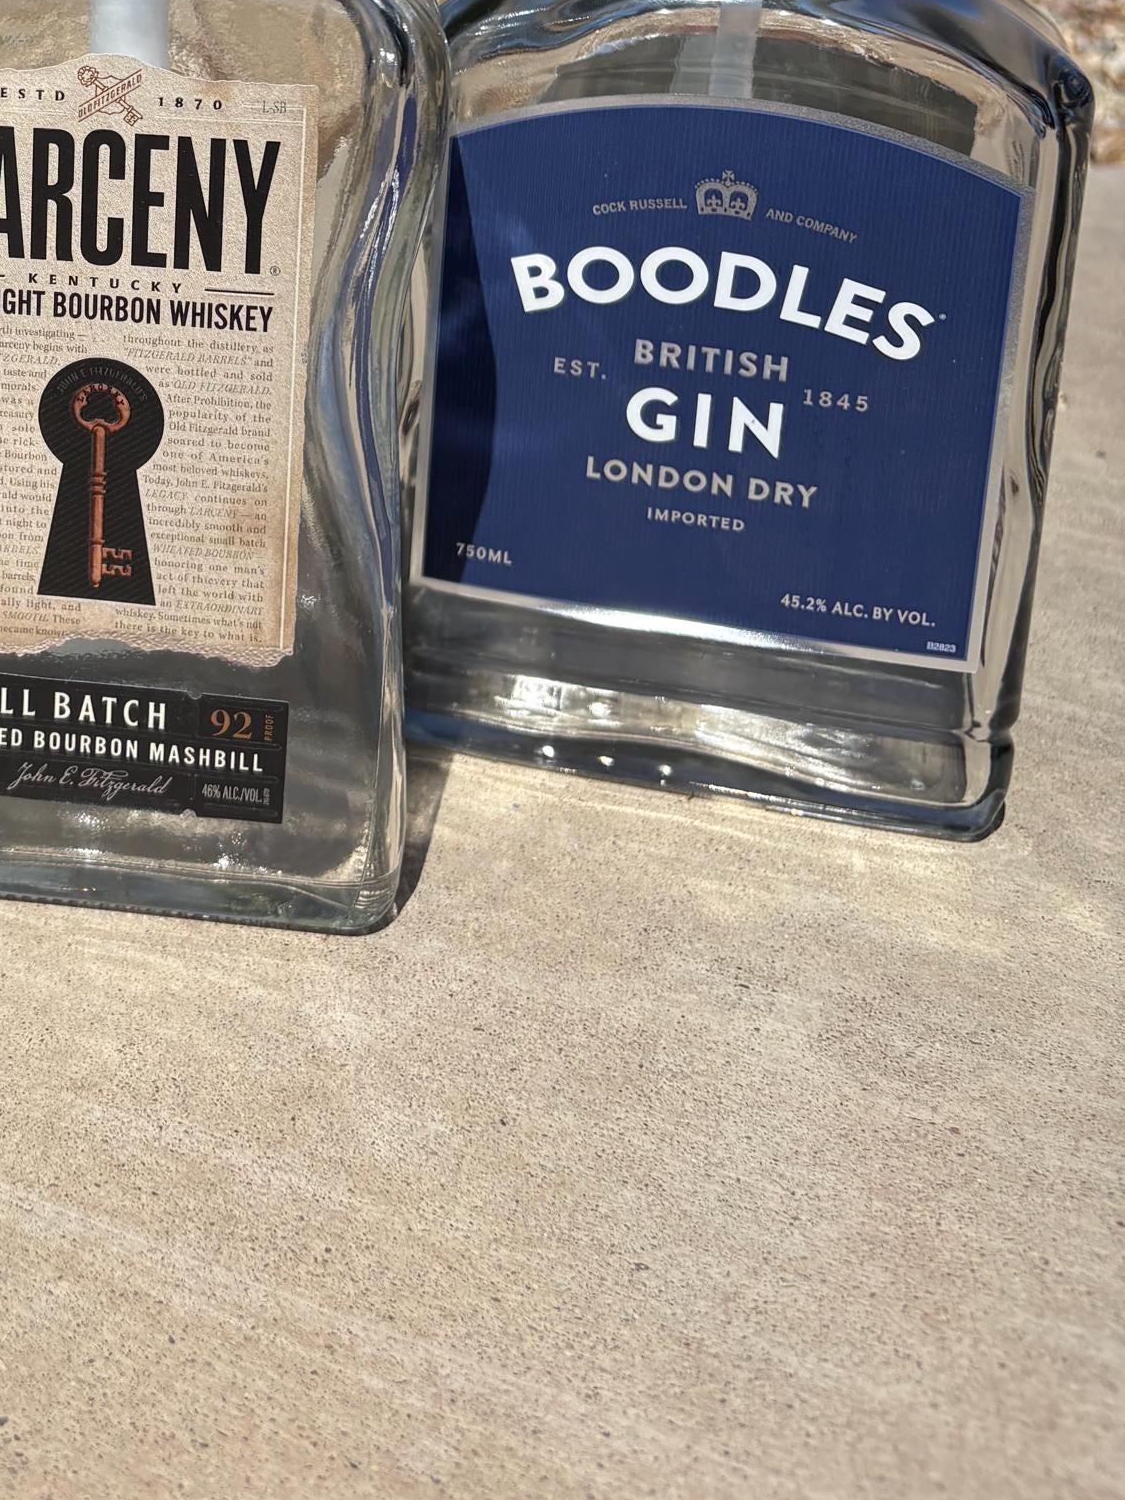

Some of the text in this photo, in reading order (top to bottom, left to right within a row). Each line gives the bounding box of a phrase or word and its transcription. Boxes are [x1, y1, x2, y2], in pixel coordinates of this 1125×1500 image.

[0, 87, 65, 102] ESTD
[78, 74, 142, 118] OLD FITZGERALD
[158, 97, 223, 111] 1870
[592, 198, 858, 244] COCK RUSSELL AND COMPANY
[28, 272, 183, 292] KENTUCKY
[53, 291, 161, 325] BOURBON
[170, 299, 273, 332] WHISKEY
[511, 246, 936, 361] BOODLES
[33, 344, 63, 353] begins
[66, 344, 87, 354] with
[123, 335, 181, 347] throughout
[187, 339, 204, 349] the
[210, 341, 258, 354] distillery
[553, 356, 607, 380] EST.
[634, 338, 789, 382] BRITISH
[177, 366, 216, 377] bottled
[224, 371, 243, 379] and
[250, 371, 273, 381] sold
[165, 393, 271, 410] After Prohibition, the
[803, 388, 869, 413] 1845
[169, 410, 271, 424] popularity of the
[626, 387, 784, 459] GIN
[169, 422, 271, 437] Old Fitzgerald brand
[167, 437, 205, 446] soared
[227, 440, 270, 451] become
[191, 452, 203, 460] of
[209, 453, 269, 465] America's
[153, 463, 176, 471] most
[180, 464, 217, 475] beloved
[143, 475, 268, 493] Today, John E. Fitzgerald's
[586, 456, 818, 509] LONDON DRY
[148, 517, 267, 534] incredibly smooth and
[646, 507, 745, 531] IMPORTED
[151, 531, 266, 547] exceptional small batch
[455, 542, 513, 565] 750ML
[154, 557, 203, 572] honoring
[235, 566, 265, 575] man's
[178, 573, 189, 581] of
[192, 575, 237, 587] thievery
[242, 580, 265, 589] that
[158, 585, 263, 602] left the world with
[27, 599, 55, 611] light,
[781, 593, 936, 627] 45.2% ALC. BY VOL.
[53, 614, 81, 625] These
[115, 609, 262, 629] whiskey. Sometimes what's not
[115, 621, 142, 631] there
[147, 623, 156, 632] is
[160, 626, 177, 634] the
[181, 627, 199, 637] key
[219, 632, 244, 641] what
[54, 692, 167, 730] BATCH
[210, 709, 252, 740] 92
[265, 714, 274, 740] PROOF
[33, 730, 139, 759] BOURBON
[149, 742, 263, 772] MASHBILL
[7, 762, 173, 800] John E. Fitzgerald
[202, 783, 221, 798] 46%
[223, 785, 262, 803] ALC./VOL.
